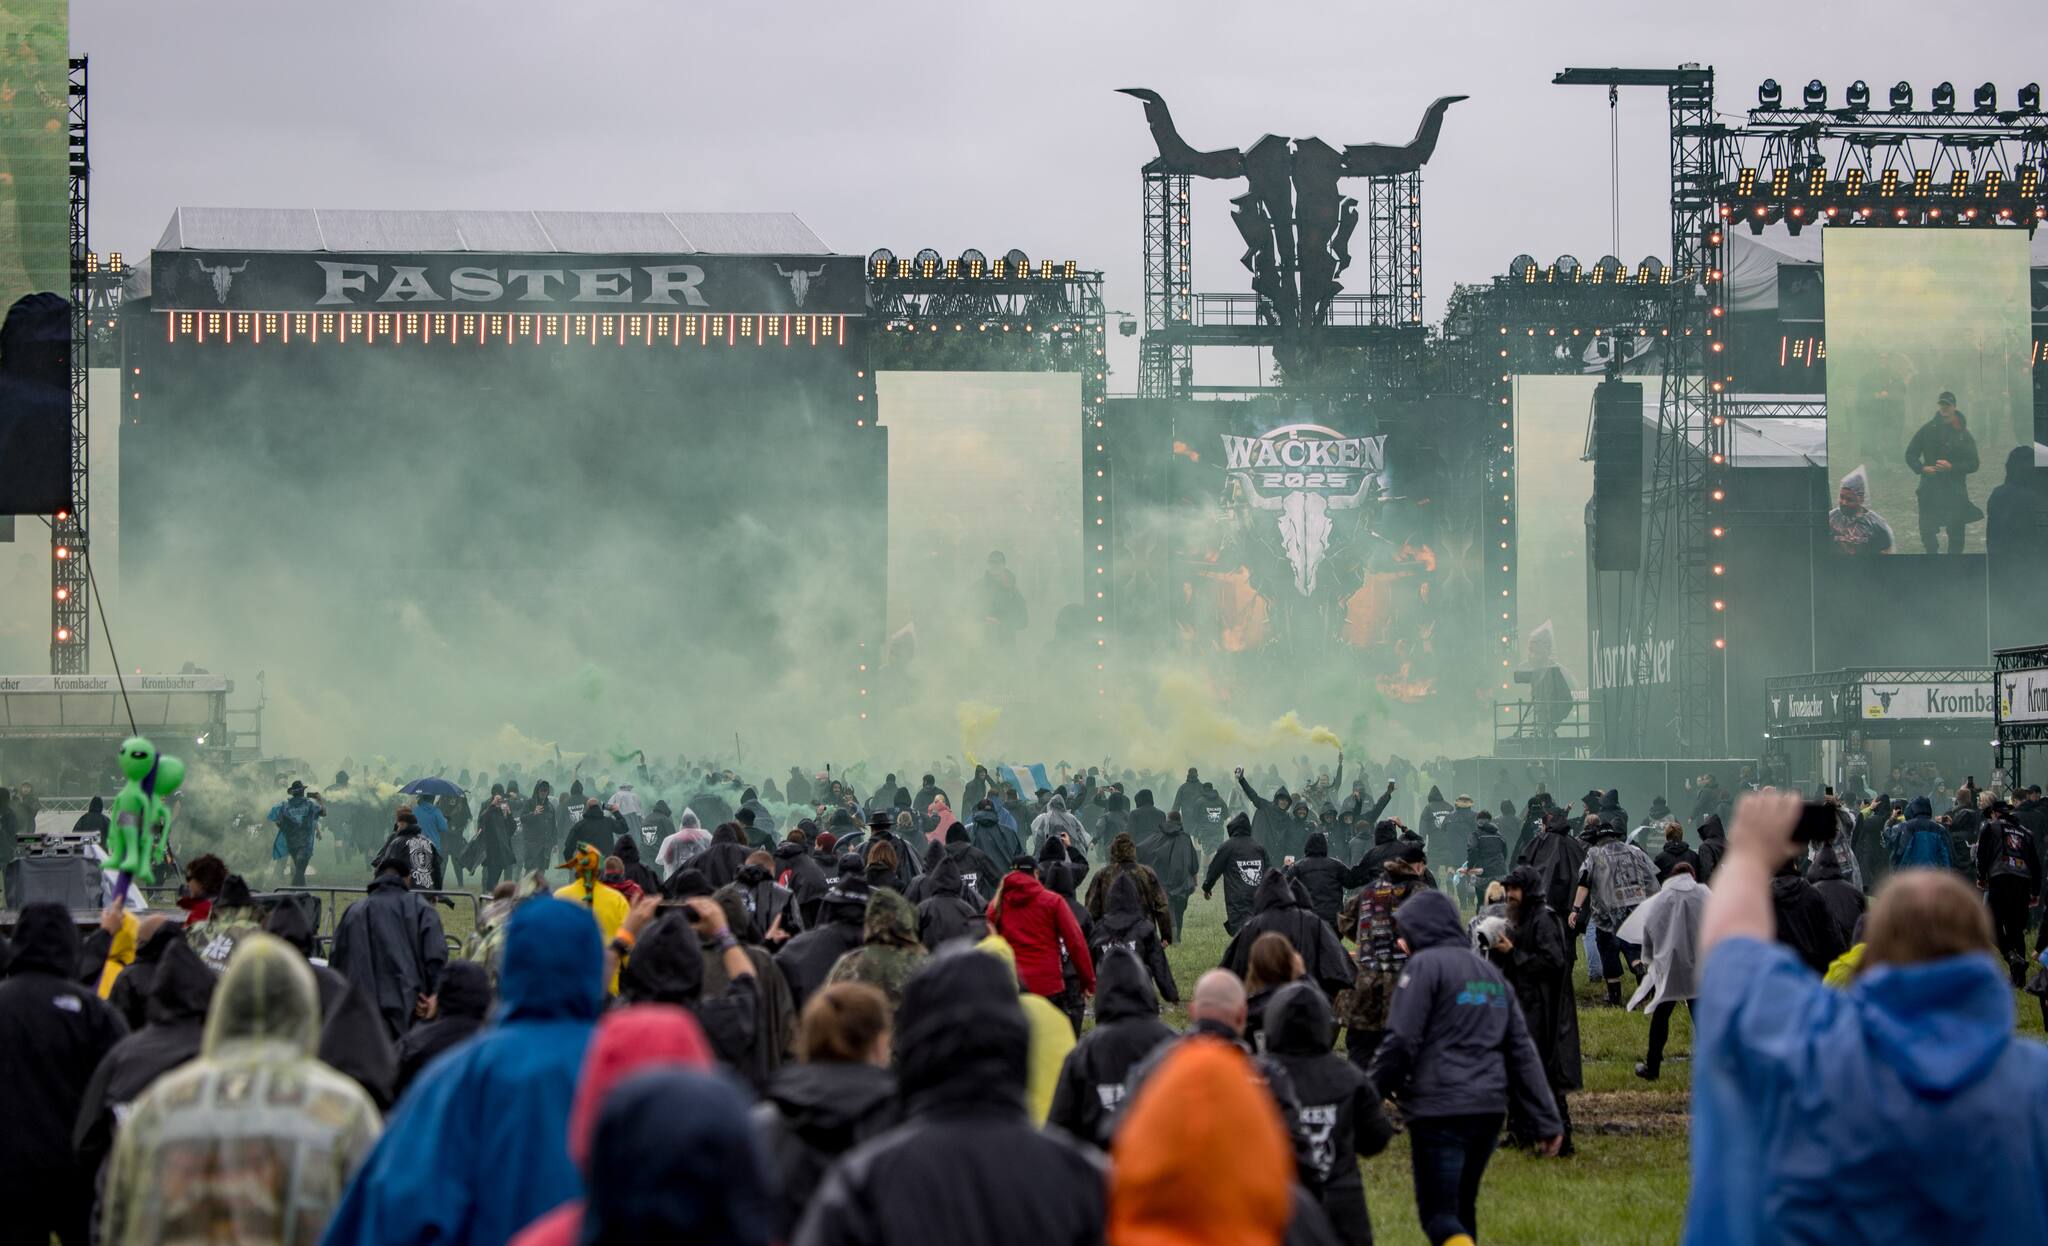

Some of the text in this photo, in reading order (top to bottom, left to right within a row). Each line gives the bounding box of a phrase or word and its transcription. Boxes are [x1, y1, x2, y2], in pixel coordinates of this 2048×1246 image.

[315, 260, 710, 307] FASTER
[1220, 434, 1388, 470] WACKEN
[1262, 472, 1347, 488] 2025
[54, 677, 108, 689] Krombacher
[141, 677, 196, 689] Krombacher
